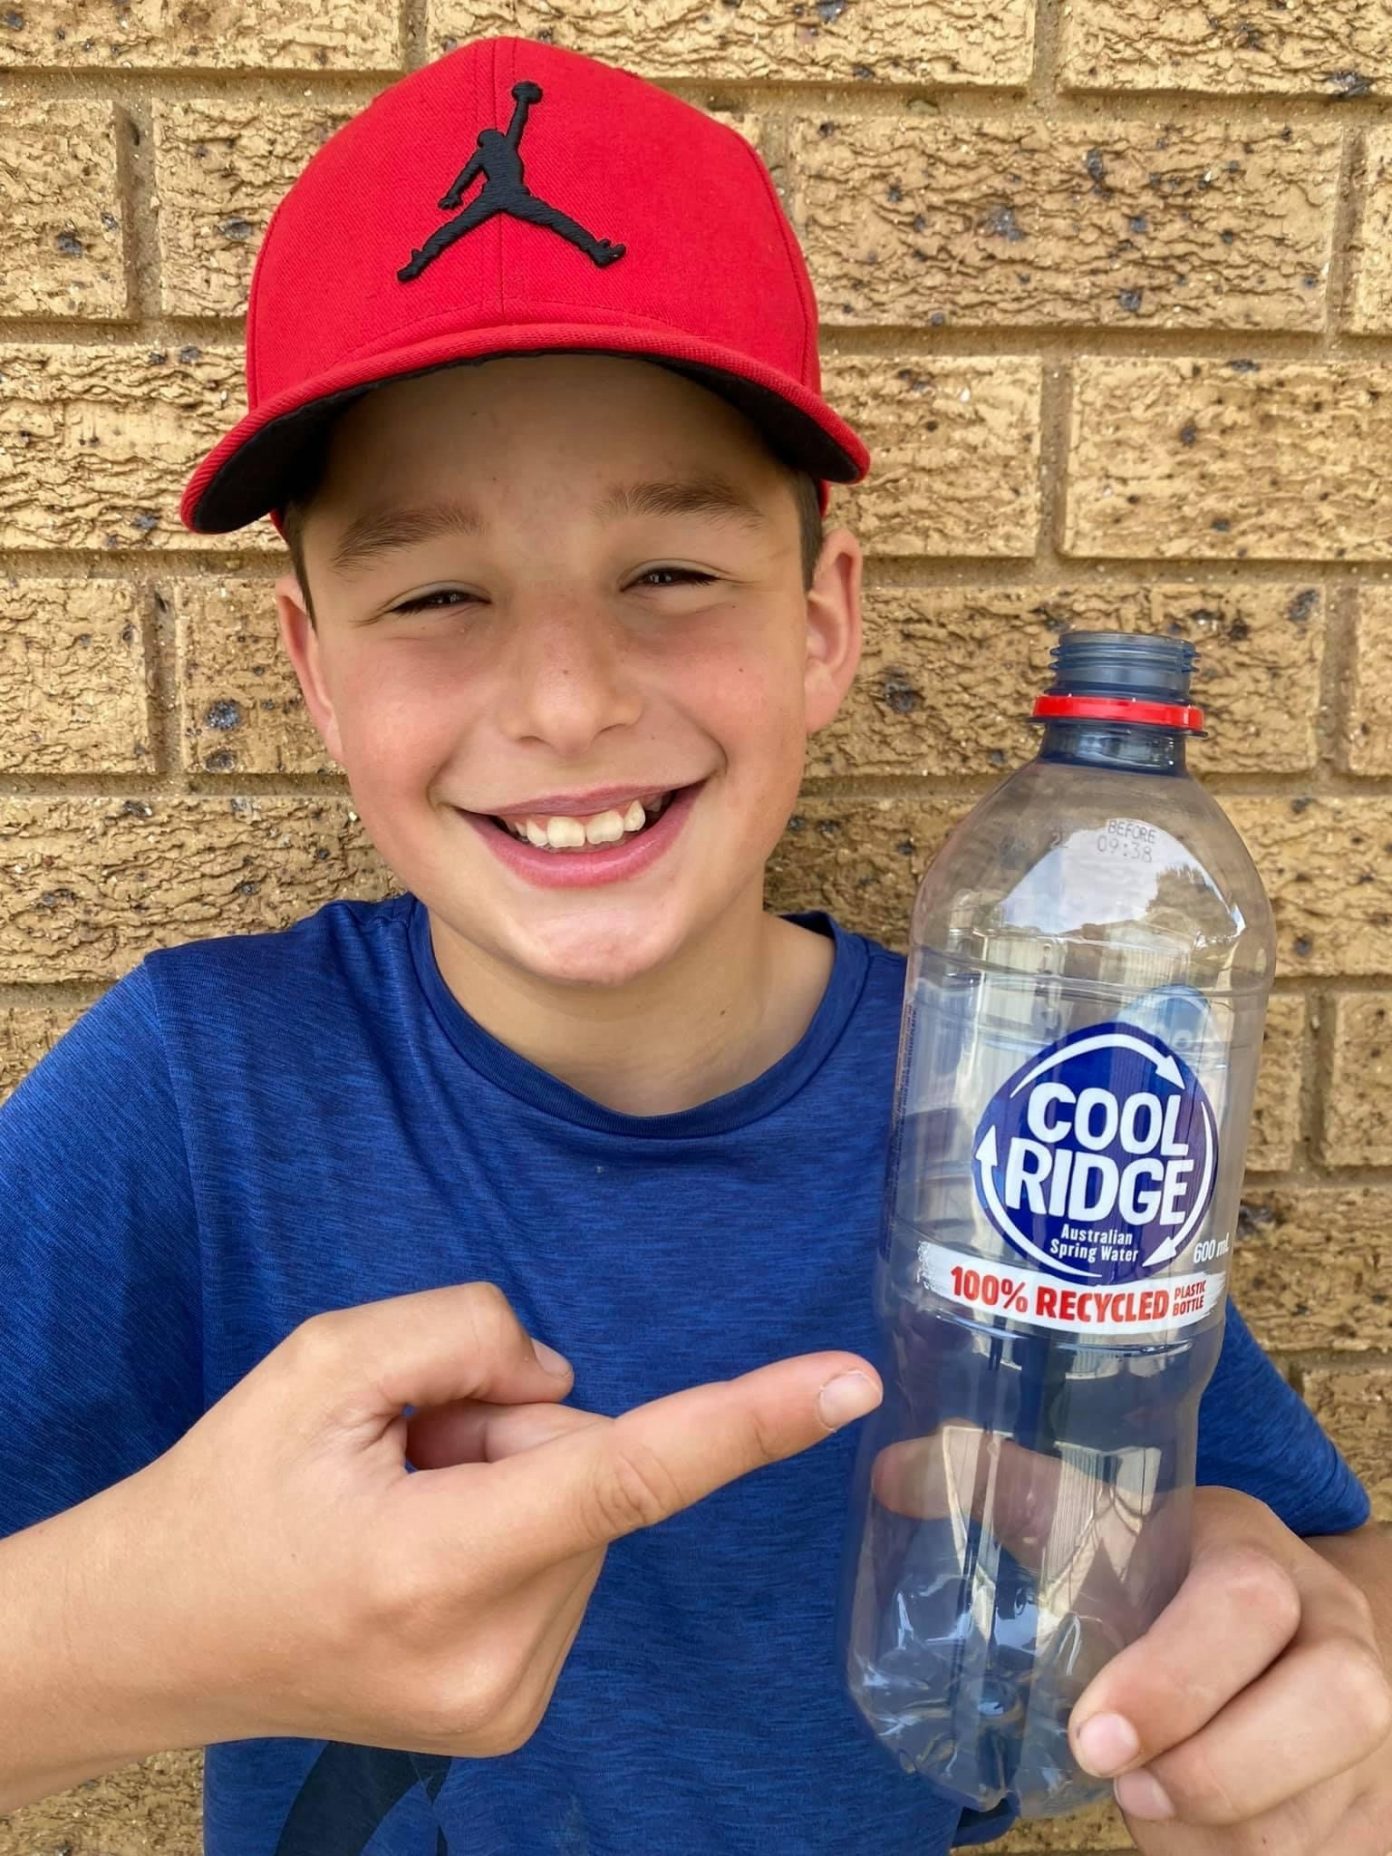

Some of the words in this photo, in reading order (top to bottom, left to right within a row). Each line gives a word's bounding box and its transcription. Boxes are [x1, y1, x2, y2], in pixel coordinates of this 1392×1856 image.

[1027, 1082, 1189, 1157] COOL
[1004, 1137, 1195, 1226] RIDGE
[1061, 1223, 1133, 1246] Australian
[1050, 1238, 1097, 1263] Spring
[1100, 1241, 1139, 1263] Water
[1193, 1239, 1215, 1264] 600
[950, 1265, 1028, 1313] 100%
[1035, 1284, 1169, 1323] RECYCLED
[1174, 1279, 1207, 1301] PLASTIC
[1172, 1295, 1205, 1317] BOTTLE
